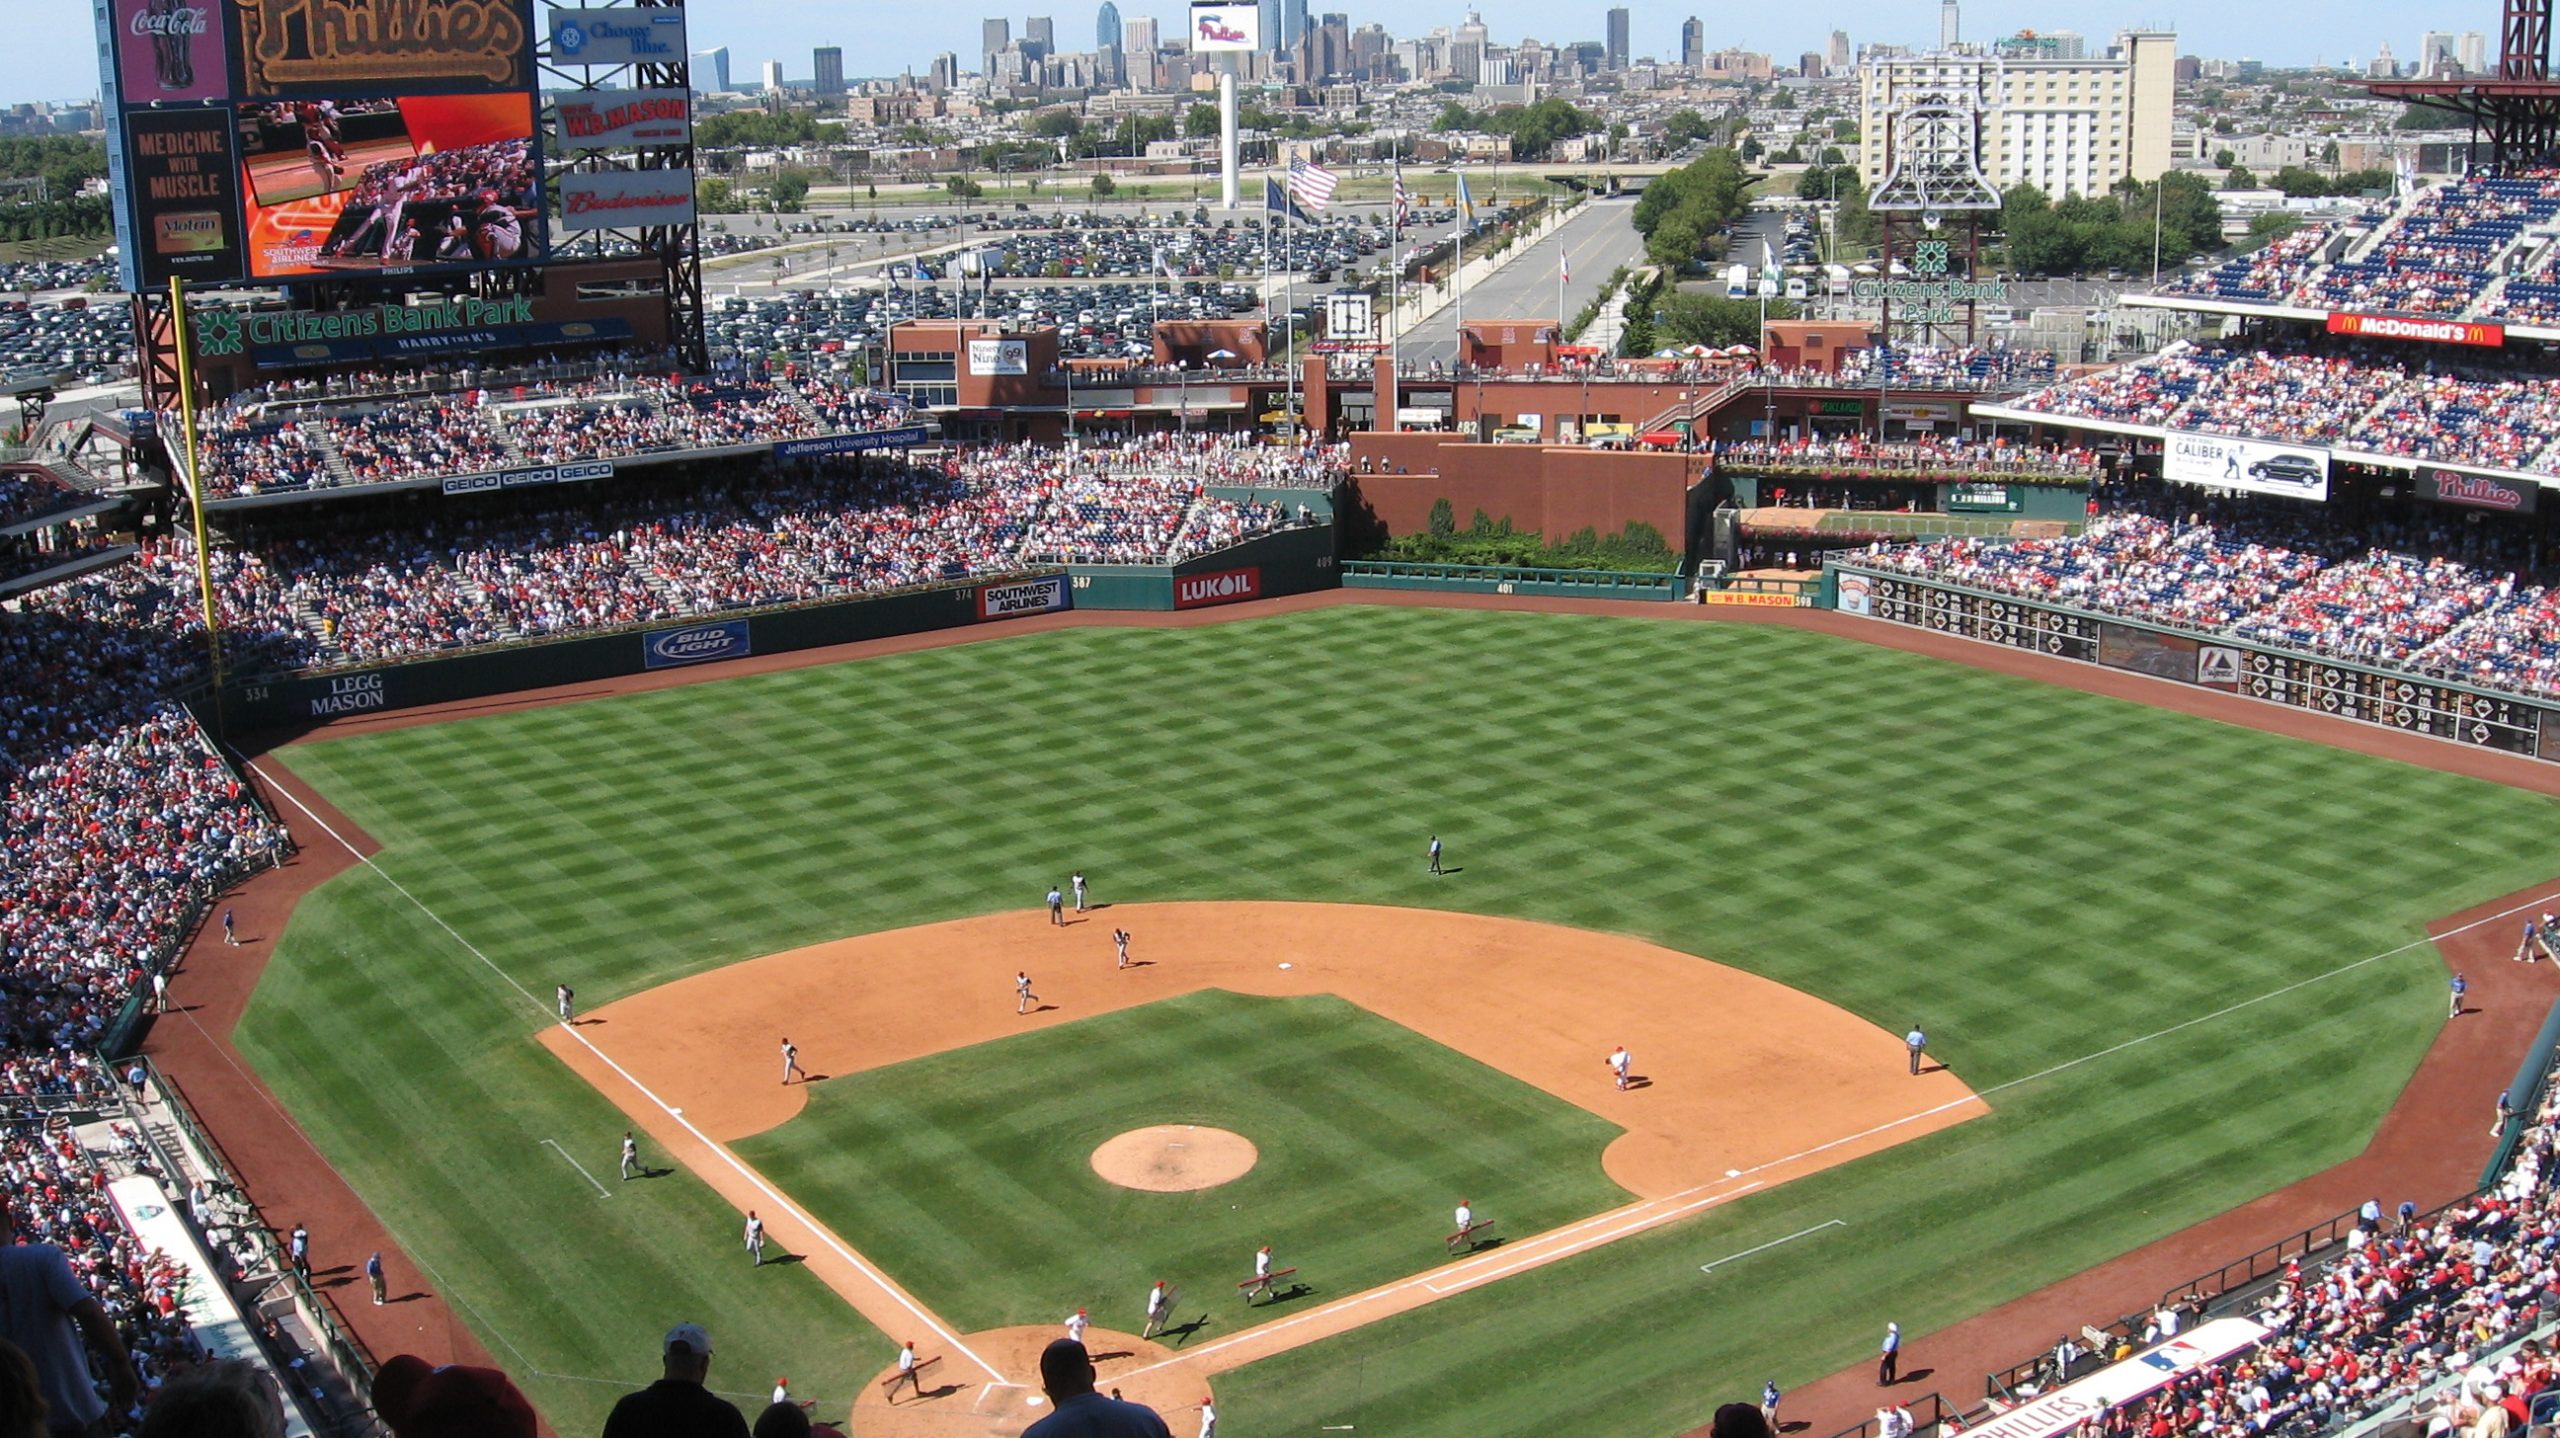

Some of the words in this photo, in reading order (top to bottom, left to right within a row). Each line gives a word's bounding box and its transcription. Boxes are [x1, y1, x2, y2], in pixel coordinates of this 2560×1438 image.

[591, 21, 650, 38] Choose
[606, 98, 686, 129] MASON
[150, 174, 220, 199] MUSCLE
[566, 189, 688, 214] Budweiser
[162, 218, 215, 232] Motrin
[1854, 279, 1943, 298] Citizens
[1949, 277, 2007, 299] Bank
[250, 309, 377, 344] Citizens
[383, 301, 460, 334] Bank
[466, 293, 534, 326] Park
[1904, 302, 1954, 323] Park
[2360, 317, 2465, 341] McDonald's
[399, 334, 450, 349] HARRY
[470, 332, 496, 344] K'S
[972, 353, 1000, 364] Nine
[785, 440, 833, 454] Jefferson
[834, 437, 880, 449] University
[881, 431, 919, 444] Hospital
[2175, 442, 2224, 460] CALIBER
[503, 470, 556, 485] GEICO
[561, 464, 611, 479] GEICO
[445, 476, 498, 492] GEICO
[2432, 470, 2521, 507] Phillies
[1072, 577, 1091, 588] 387
[1182, 574, 1251, 601] LUKOIL
[1497, 584, 1513, 594] 401
[987, 582, 1058, 602] SOUTHWEST
[1748, 595, 1792, 606] MASON
[998, 595, 1049, 611] AIRLINES
[676, 630, 725, 643] BUD
[667, 637, 735, 654] LIGHT
[331, 674, 383, 694] LEGG
[245, 687, 269, 701] 334
[311, 690, 385, 715] MASON
